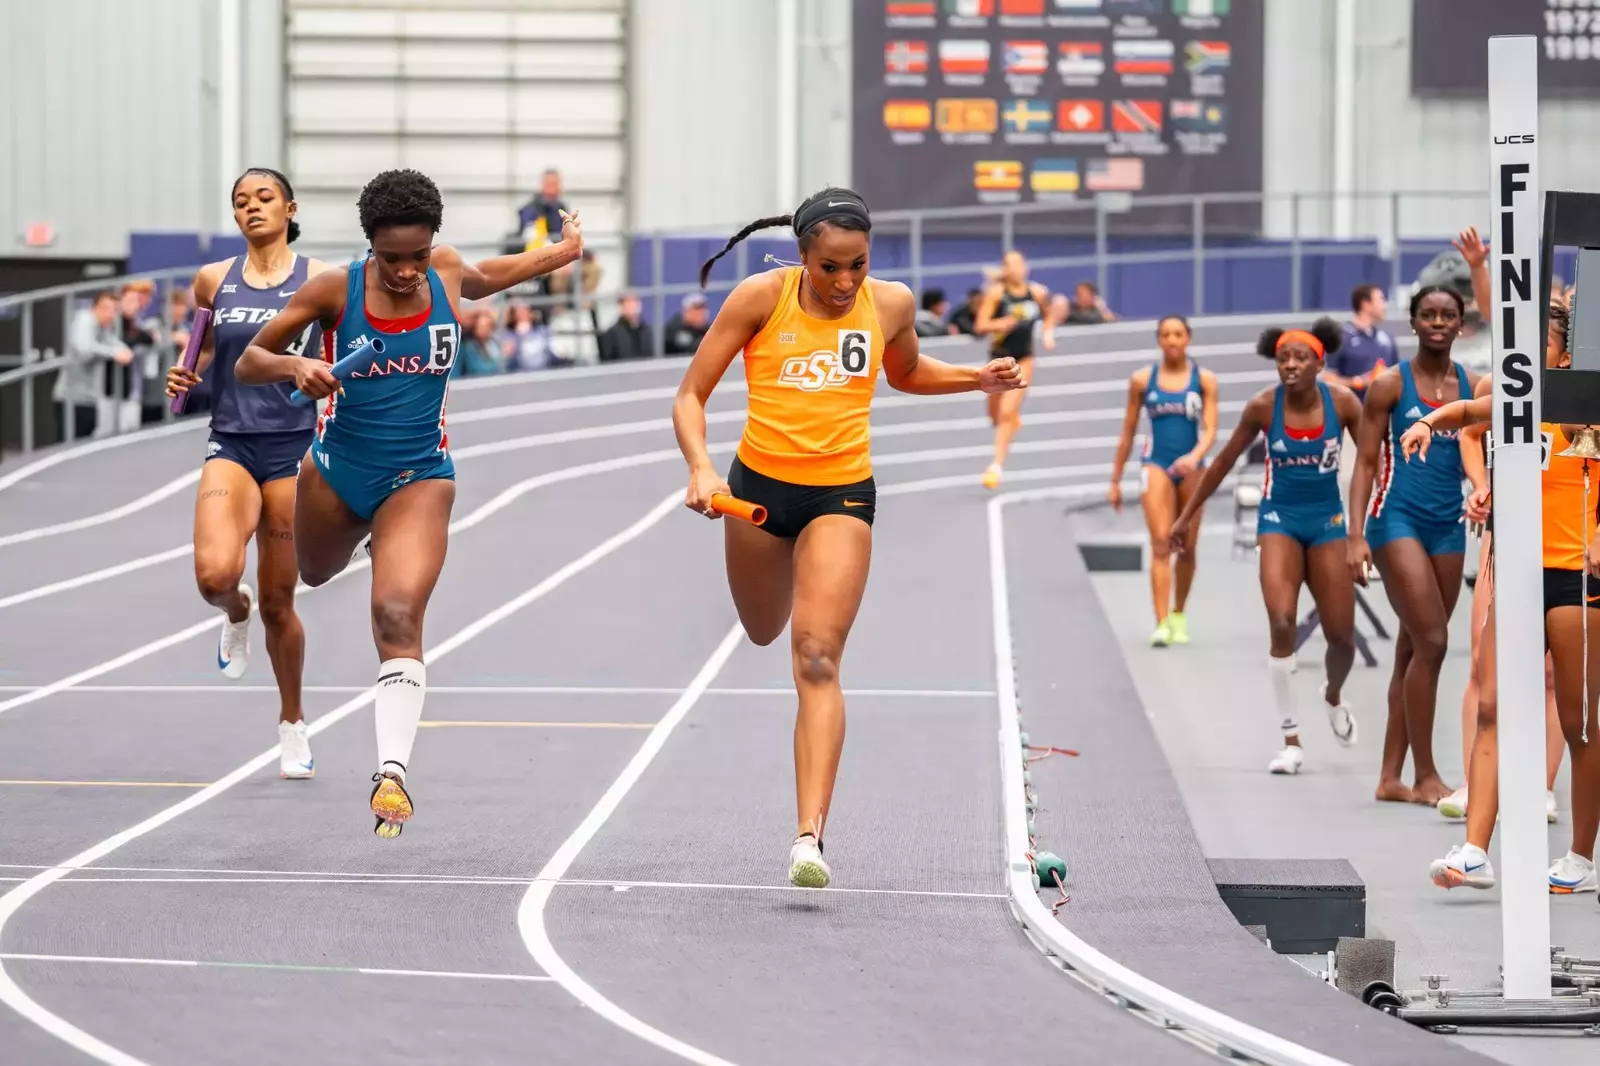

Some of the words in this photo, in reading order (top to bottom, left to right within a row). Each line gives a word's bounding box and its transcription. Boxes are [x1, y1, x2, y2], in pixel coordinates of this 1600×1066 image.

[1494, 134, 1535, 145] UCS
[213, 306, 284, 327] K-STA
[1500, 163, 1534, 444] FINISH
[435, 329, 452, 366] 5
[842, 332, 866, 373] 6
[351, 356, 446, 378] ANS
